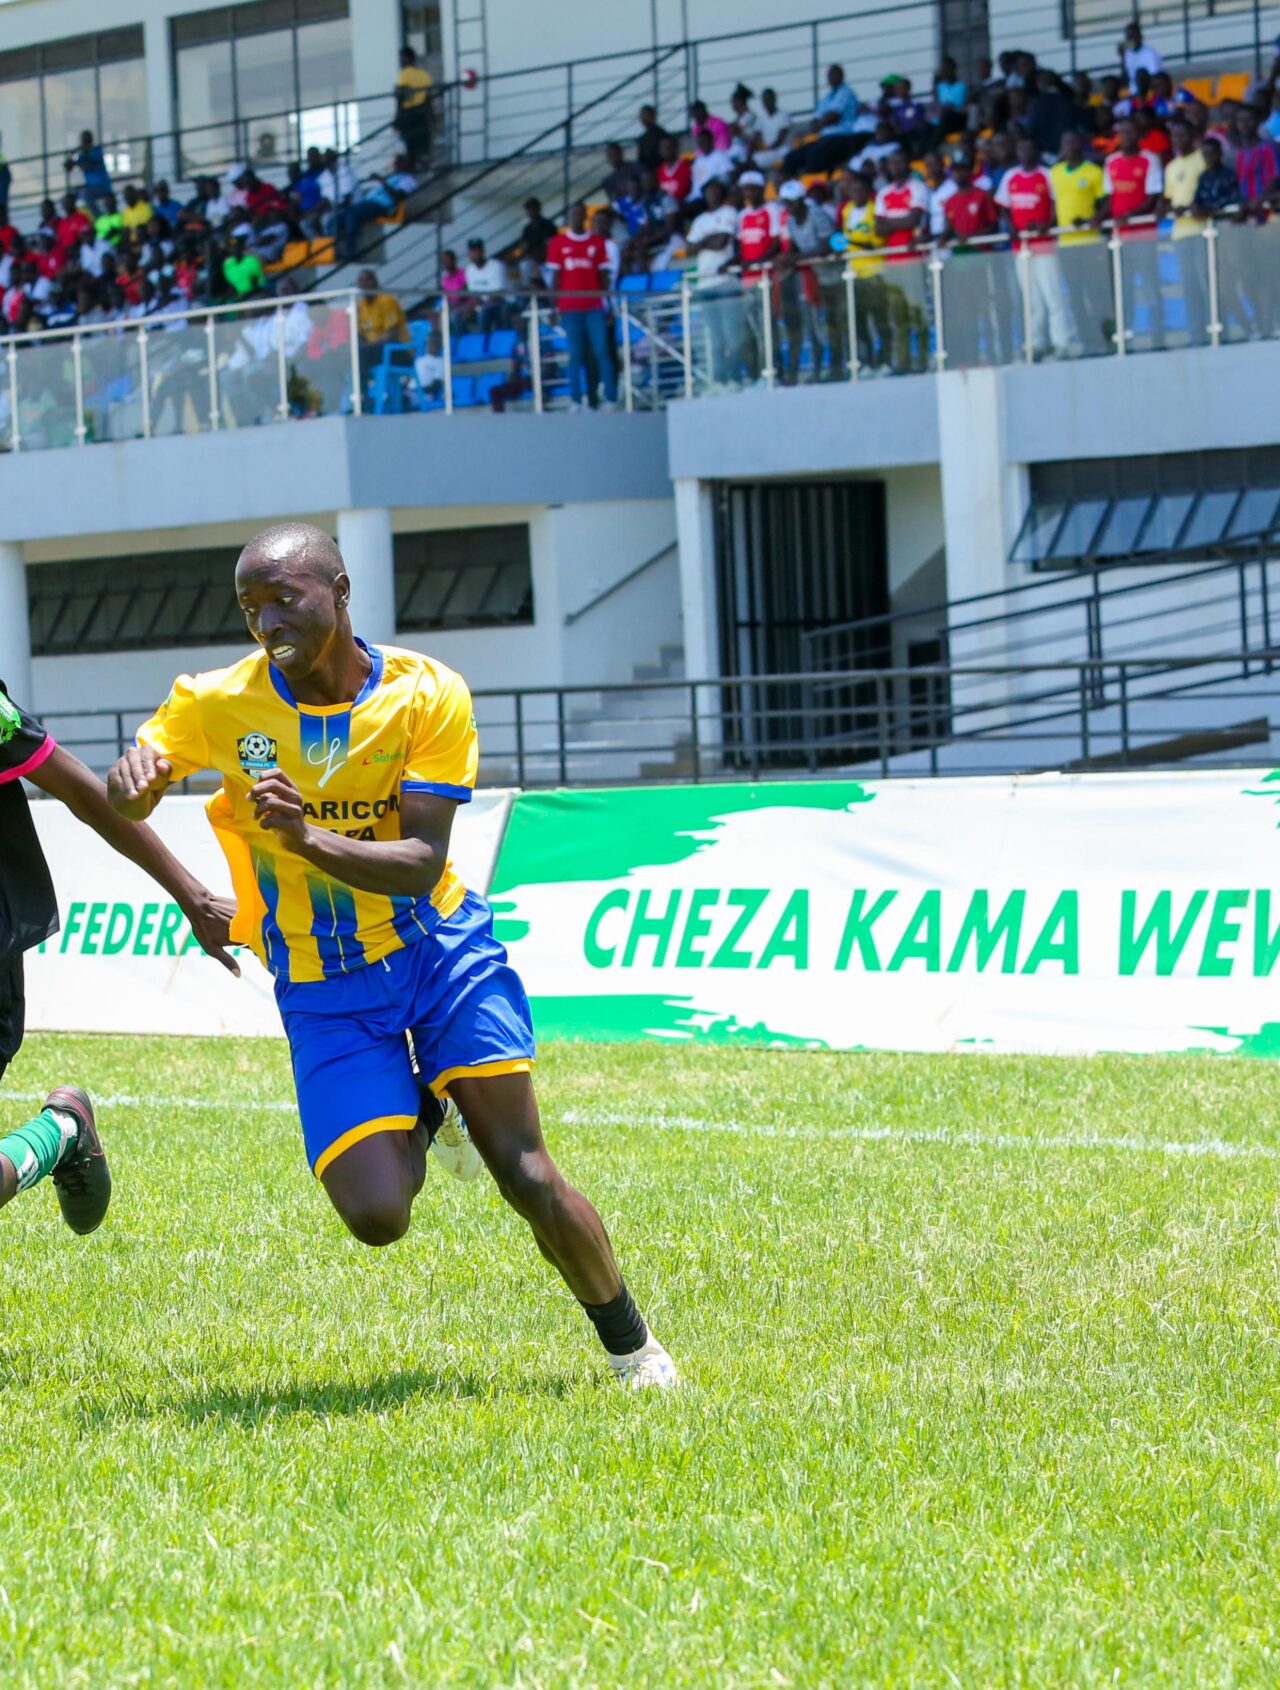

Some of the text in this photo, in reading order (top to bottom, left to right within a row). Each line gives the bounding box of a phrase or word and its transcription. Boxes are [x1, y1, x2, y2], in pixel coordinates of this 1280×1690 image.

[59, 902, 240, 956] FEDER
[582, 887, 810, 970] CHEZA
[834, 888, 1080, 975] KAMA
